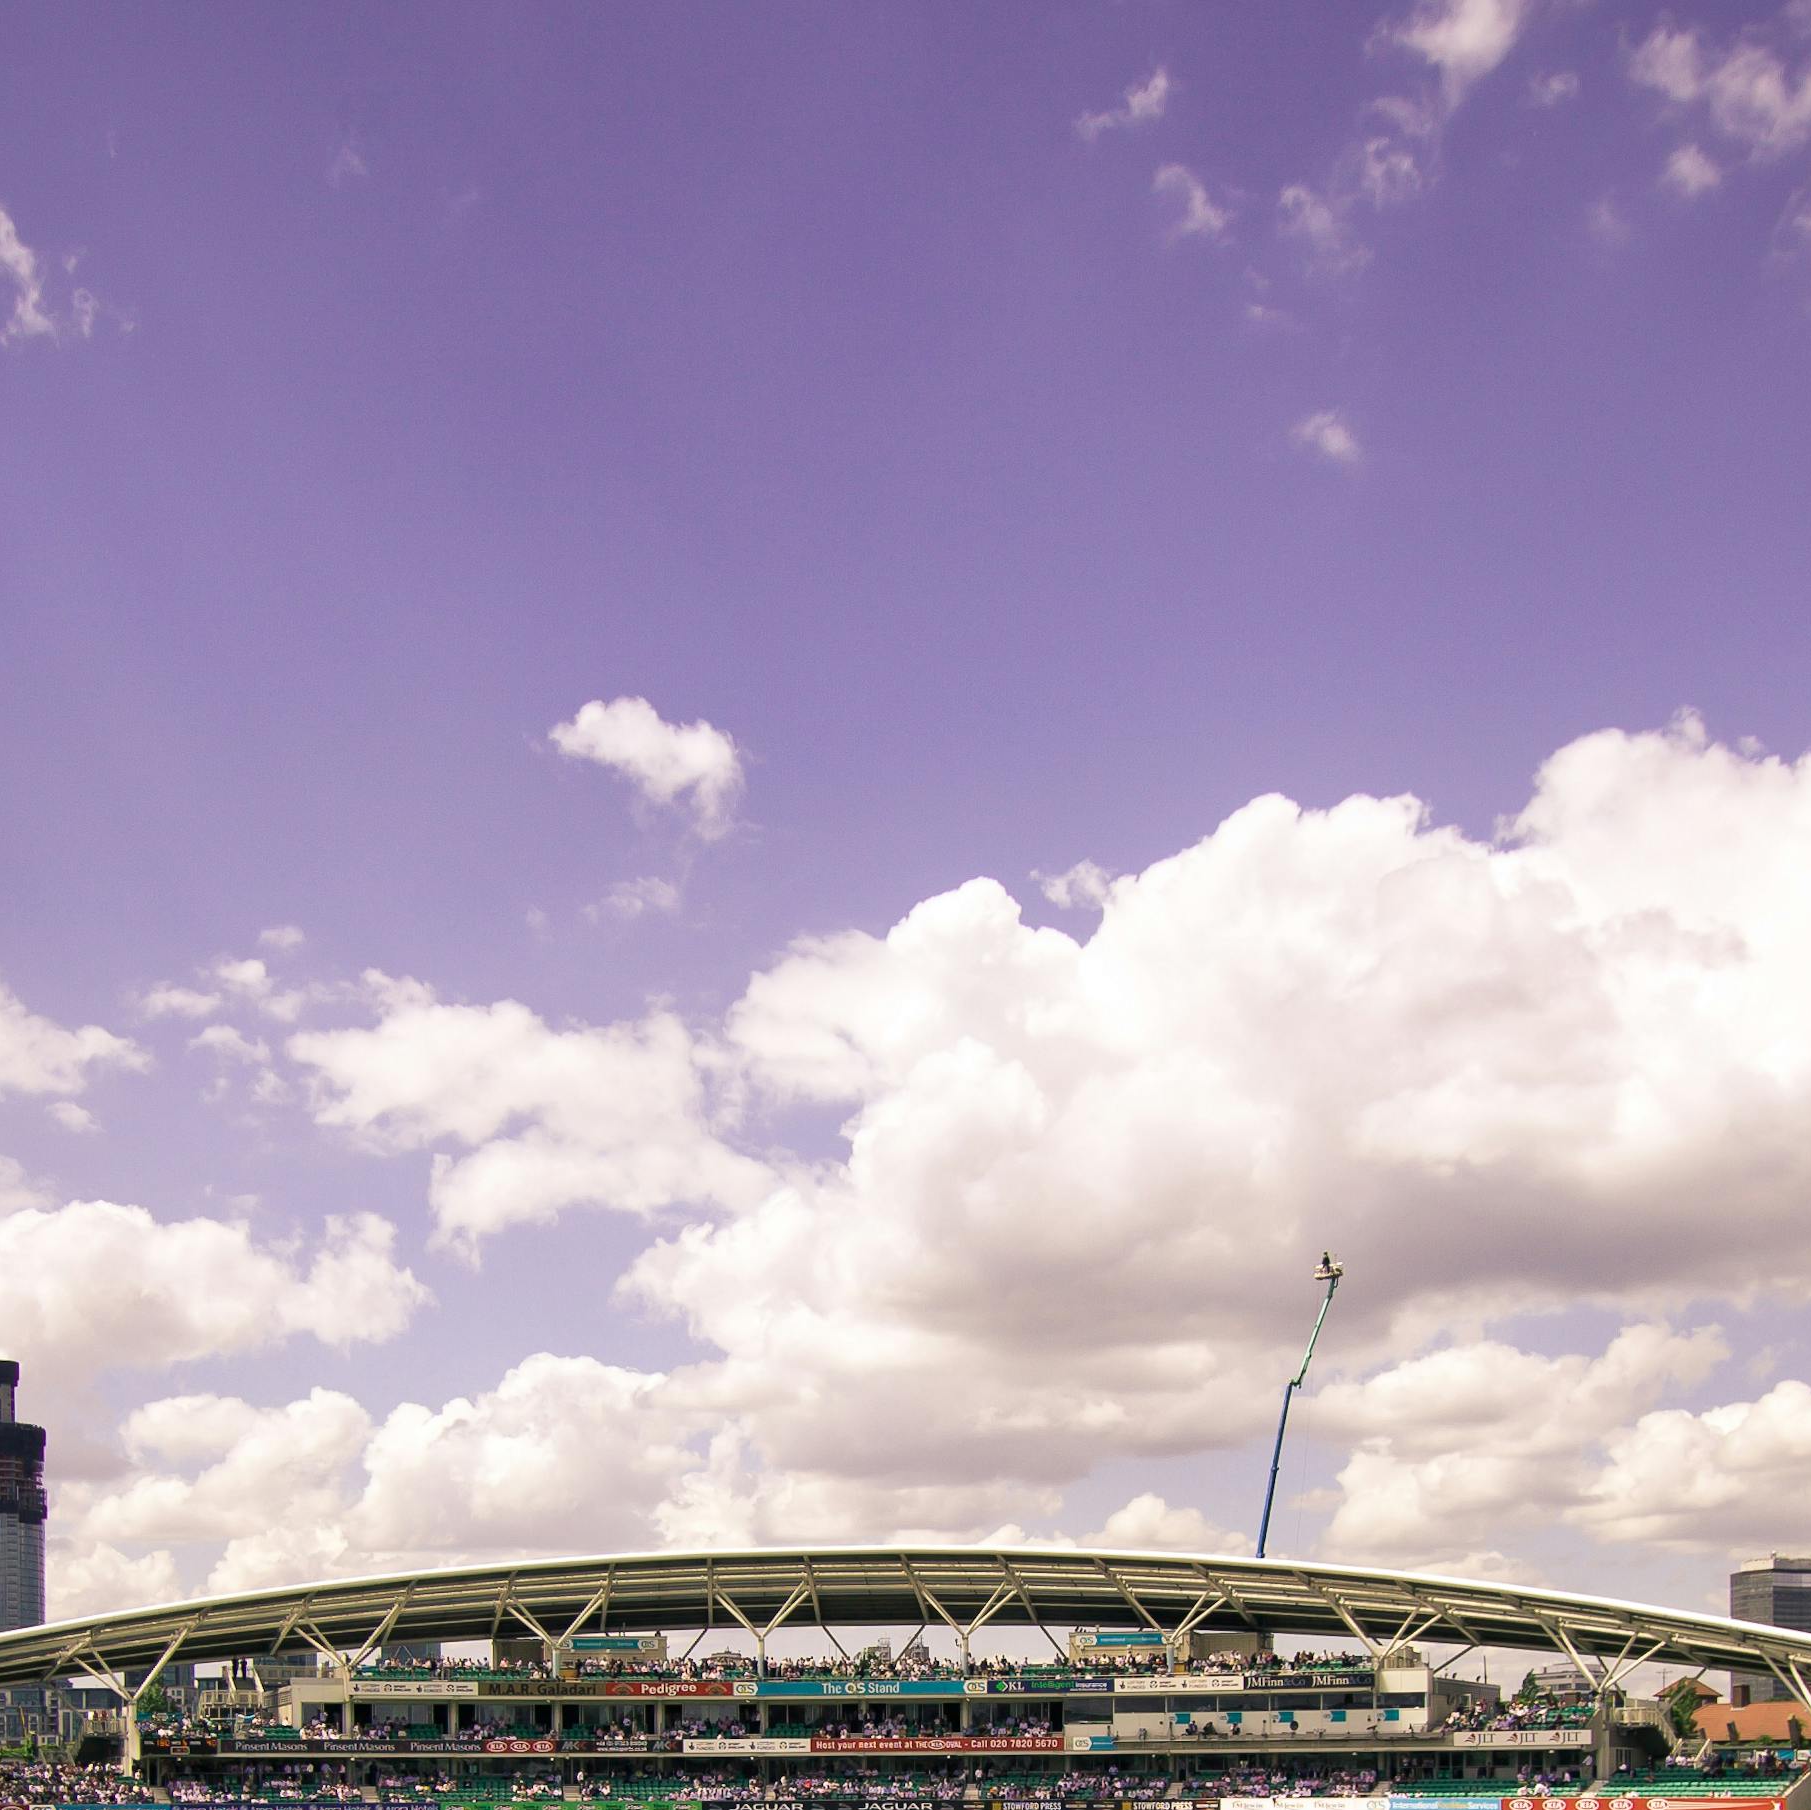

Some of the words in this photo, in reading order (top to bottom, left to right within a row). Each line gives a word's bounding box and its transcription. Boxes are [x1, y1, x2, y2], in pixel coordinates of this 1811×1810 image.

[489, 1684, 533, 1696] M.A.R.
[537, 1683, 596, 1695] Galadari
[641, 1683, 697, 1696] Pedigree
[822, 1682, 837, 1693] The
[868, 1682, 900, 1694] Stand
[1008, 1680, 1025, 1691] KL
[1477, 1733, 1495, 1745] JLT
[1519, 1733, 1538, 1745] JLT
[1562, 1732, 1582, 1744] JLT
[235, 1741, 271, 1751] Pinsent
[271, 1741, 308, 1751] Masons
[323, 1741, 359, 1751] Pinsent
[359, 1741, 396, 1751] Masons
[410, 1741, 445, 1751] Pinsent
[446, 1741, 481, 1751] Masons
[816, 1740, 835, 1750] Host
[837, 1741, 857, 1752] your
[858, 1741, 877, 1750] next
[878, 1741, 902, 1750] event
[904, 1741, 913, 1750] at
[915, 1741, 928, 1750] THE
[944, 1740, 961, 1749] OVAL
[971, 1740, 987, 1748] Call
[990, 1739, 1010, 1748] 020
[1011, 1739, 1033, 1748] 7820
[1035, 1739, 1058, 1748] 5670
[729, 1802, 804, 1810] JAGUAR
[858, 1802, 933, 1810] JAGUAR
[1003, 1801, 1039, 1810] STOWFORD
[1040, 1801, 1062, 1810] PRESS
[1133, 1801, 1170, 1810] STOWFORD
[1171, 1801, 1194, 1810] PRESS
[1469, 1801, 1498, 1810] Services
